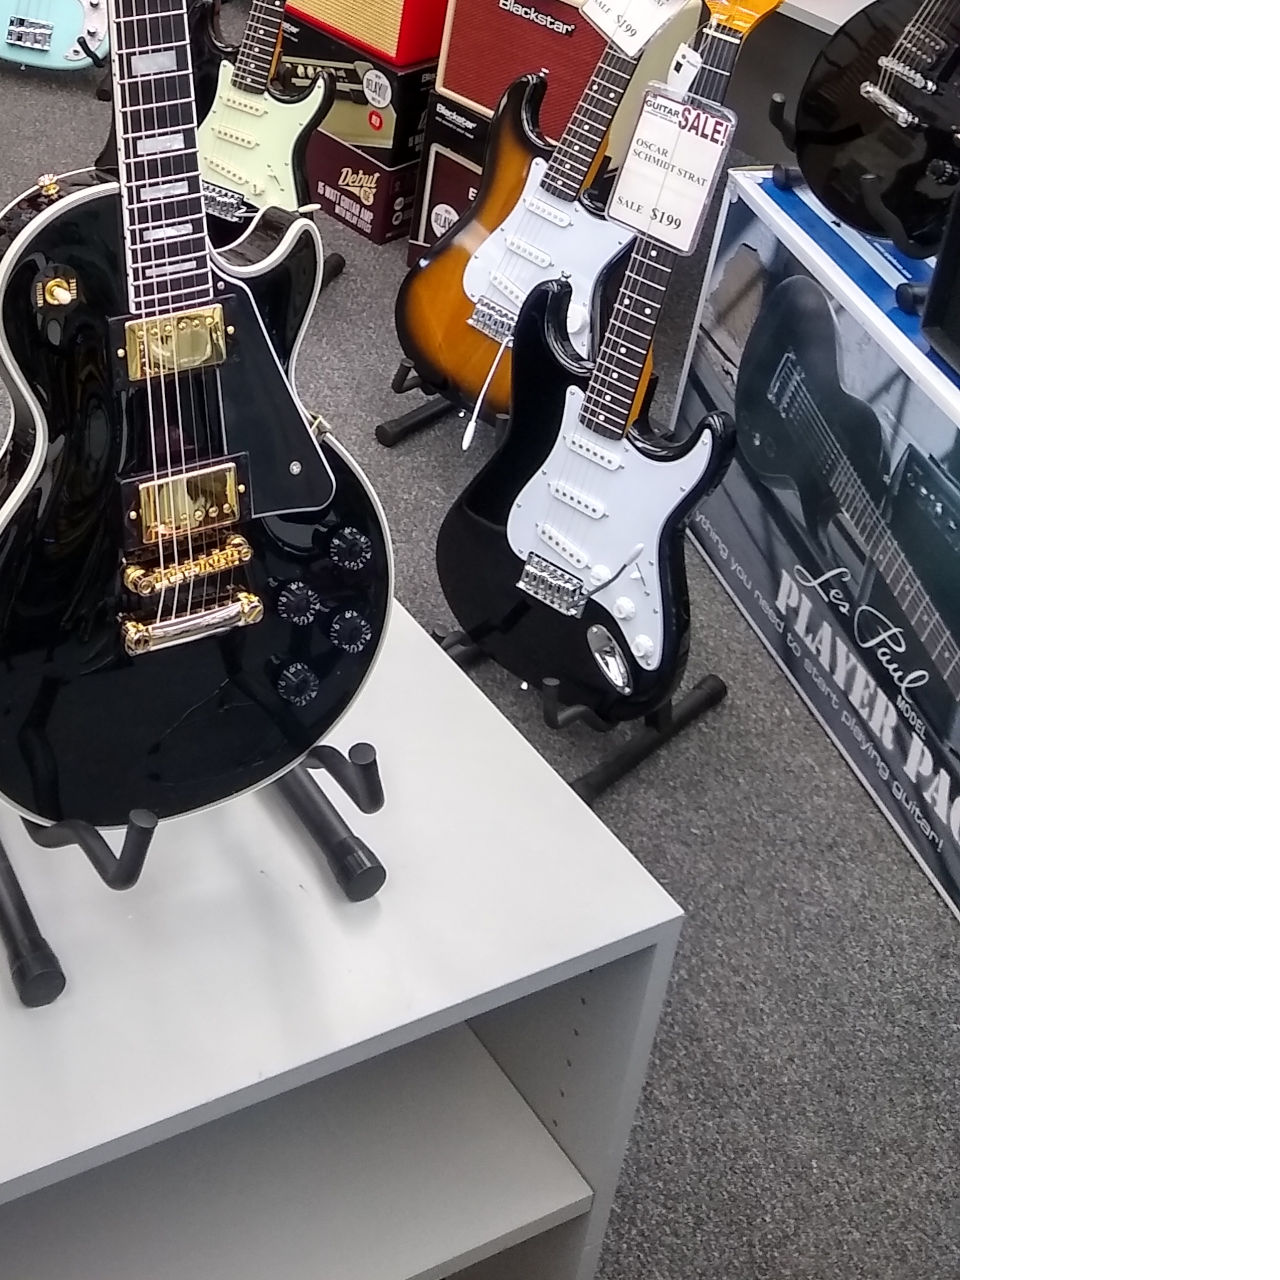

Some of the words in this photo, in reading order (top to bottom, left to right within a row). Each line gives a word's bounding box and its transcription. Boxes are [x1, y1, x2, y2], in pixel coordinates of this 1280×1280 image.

[616, 14, 637, 38] $199
[436, 103, 478, 130] Blackstar
[645, 100, 680, 119] GUITAR
[678, 107, 730, 147] SALE!
[636, 137, 669, 158] OSCAR
[338, 167, 381, 188] Debut
[632, 148, 676, 173] SCHMIDT
[677, 168, 707, 187] STRAT
[325, 184, 341, 204] WATT
[340, 194, 361, 217] GUITAR
[360, 207, 374, 224] AMP
[617, 195, 644, 215] SALE
[650, 207, 682, 230] $199
[793, 565, 851, 617] Les
[854, 604, 930, 704] Paul
[775, 569, 899, 751] PLAYER
[695, 510, 729, 560] ything
[730, 557, 752, 590] you
[754, 590, 785, 634] need
[787, 633, 802, 657] to
[804, 658, 840, 709] start
[841, 710, 890, 781] playing
[892, 780, 944, 853] guitar!
[896, 694, 927, 741] MODEL
